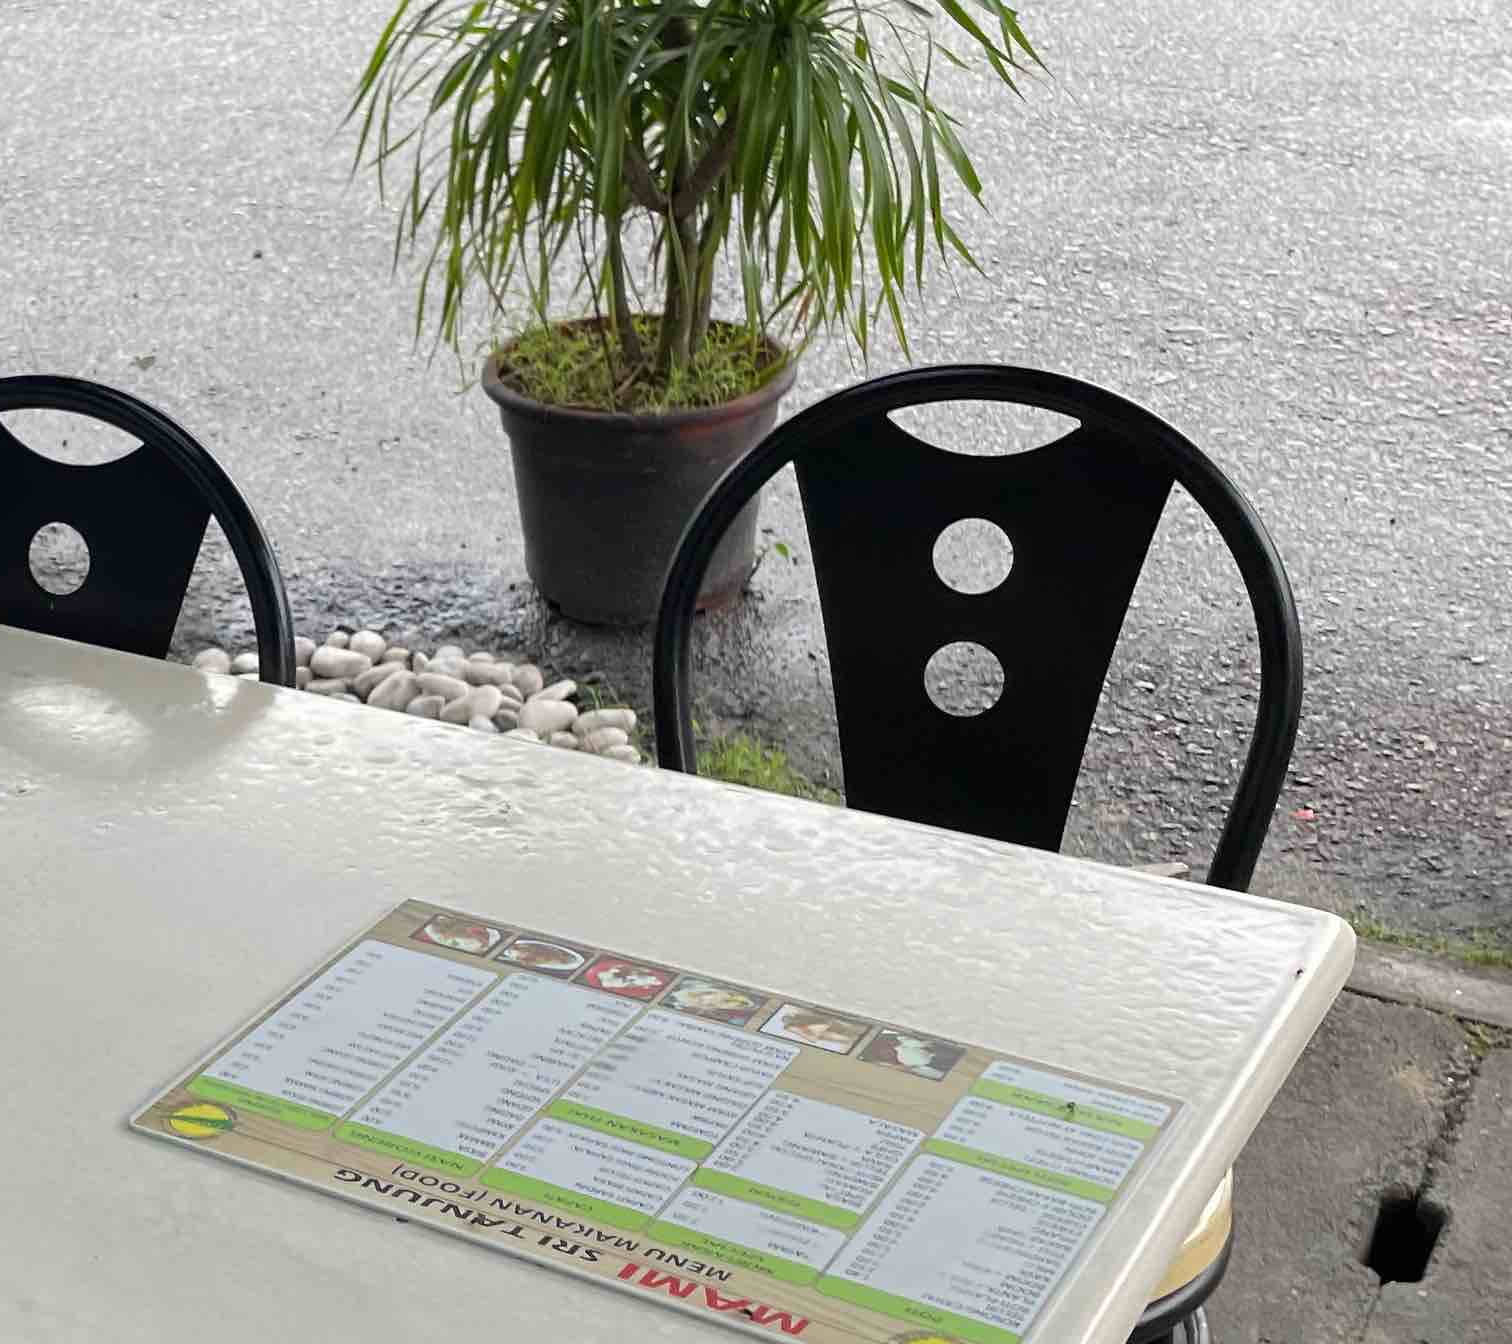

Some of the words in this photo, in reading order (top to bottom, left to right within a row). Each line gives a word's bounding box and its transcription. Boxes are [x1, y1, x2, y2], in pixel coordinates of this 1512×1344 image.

[330, 1167, 531, 1239] TANJUNG
[387, 1163, 488, 1202] (FOOD)
[487, 1197, 641, 1252] MAKANAN
[535, 1233, 605, 1263] SRI
[641, 1246, 733, 1281] MENU
[615, 1261, 810, 1336] MAMI
